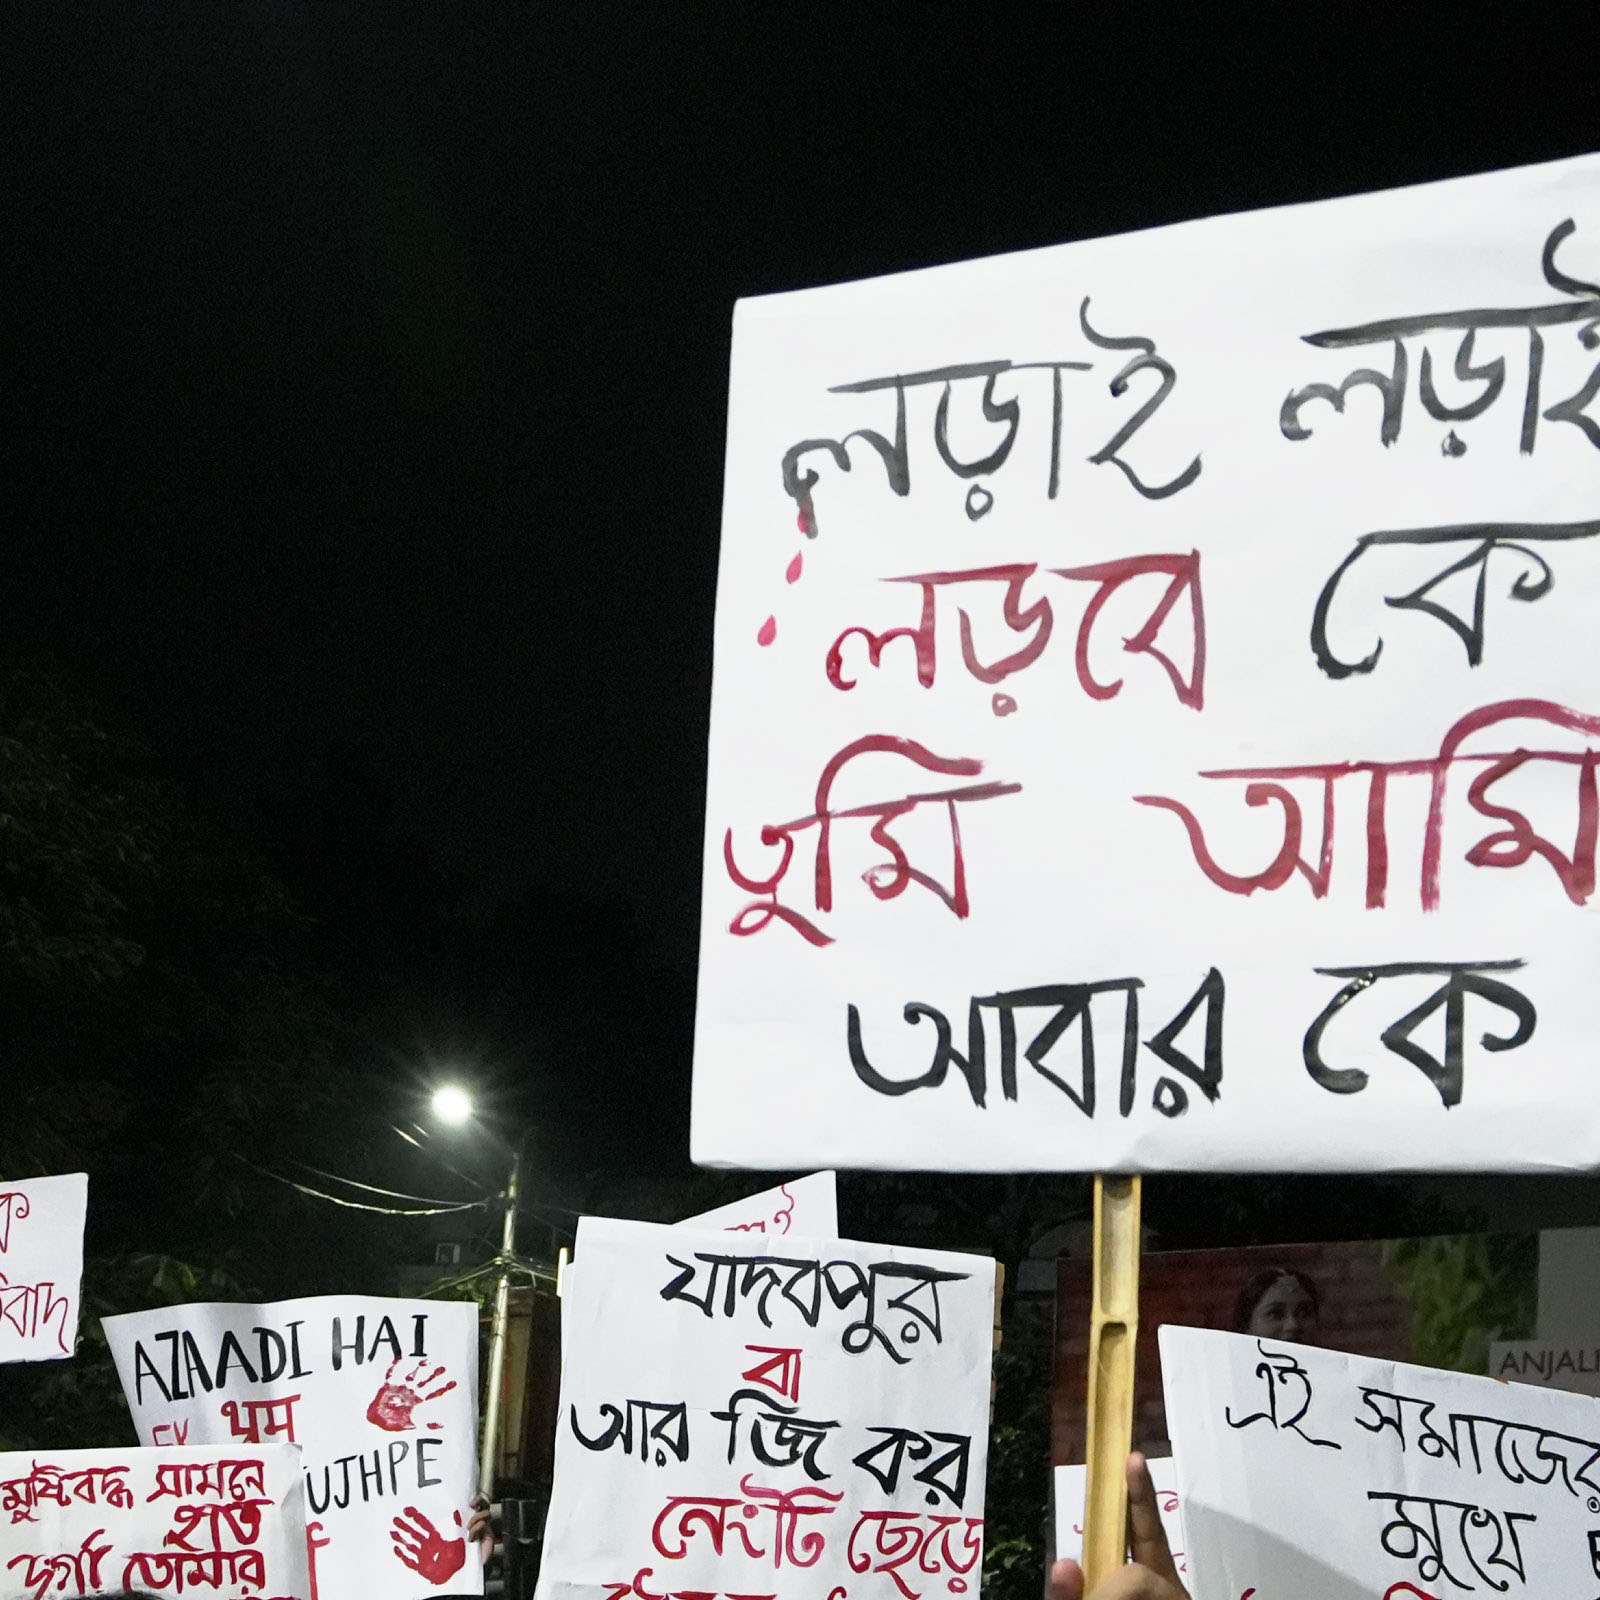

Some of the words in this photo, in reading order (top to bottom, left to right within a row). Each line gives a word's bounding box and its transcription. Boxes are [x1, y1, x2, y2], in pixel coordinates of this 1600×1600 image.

[781, 296, 1203, 539] লড়াই
[824, 548, 1209, 717] লড়বে
[723, 732, 1024, 949] তুমি
[846, 964, 1227, 1120] আবার
[1302, 958, 1541, 1111] কে
[133, 1320, 313, 1406] AZAADI
[332, 1314, 429, 1371] HAI
[660, 1251, 972, 1364] যাদবপুর
[741, 1344, 803, 1403] বা
[1225, 1338, 1341, 1450] এই
[1499, 1348, 1600, 1381] ANJALI
[303, 1438, 443, 1515] UJHPE
[570, 1399, 690, 1468] আর
[709, 1388, 842, 1481] জি
[852, 1426, 972, 1510] কর
[1367, 1490, 1537, 1592] মুখে
